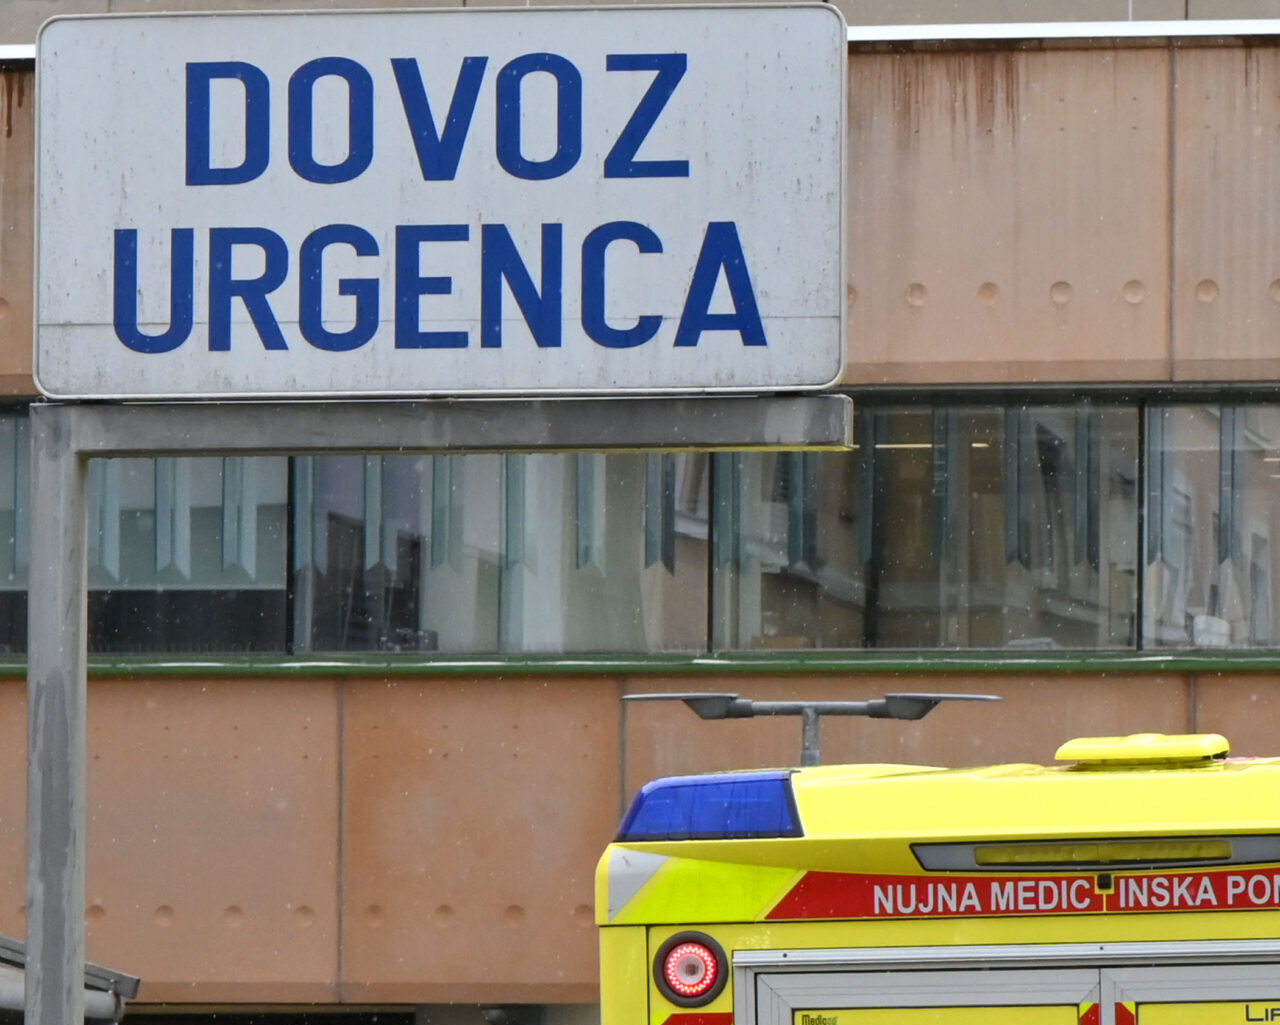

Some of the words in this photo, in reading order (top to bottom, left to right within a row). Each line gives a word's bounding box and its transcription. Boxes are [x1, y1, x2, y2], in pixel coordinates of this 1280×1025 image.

[185, 53, 690, 186] DOVOZ
[113, 221, 767, 353] URGENCA
[873, 882, 981, 914] NUJNA
[990, 879, 1091, 911] MEDIC
[1119, 875, 1217, 908] INSKA
